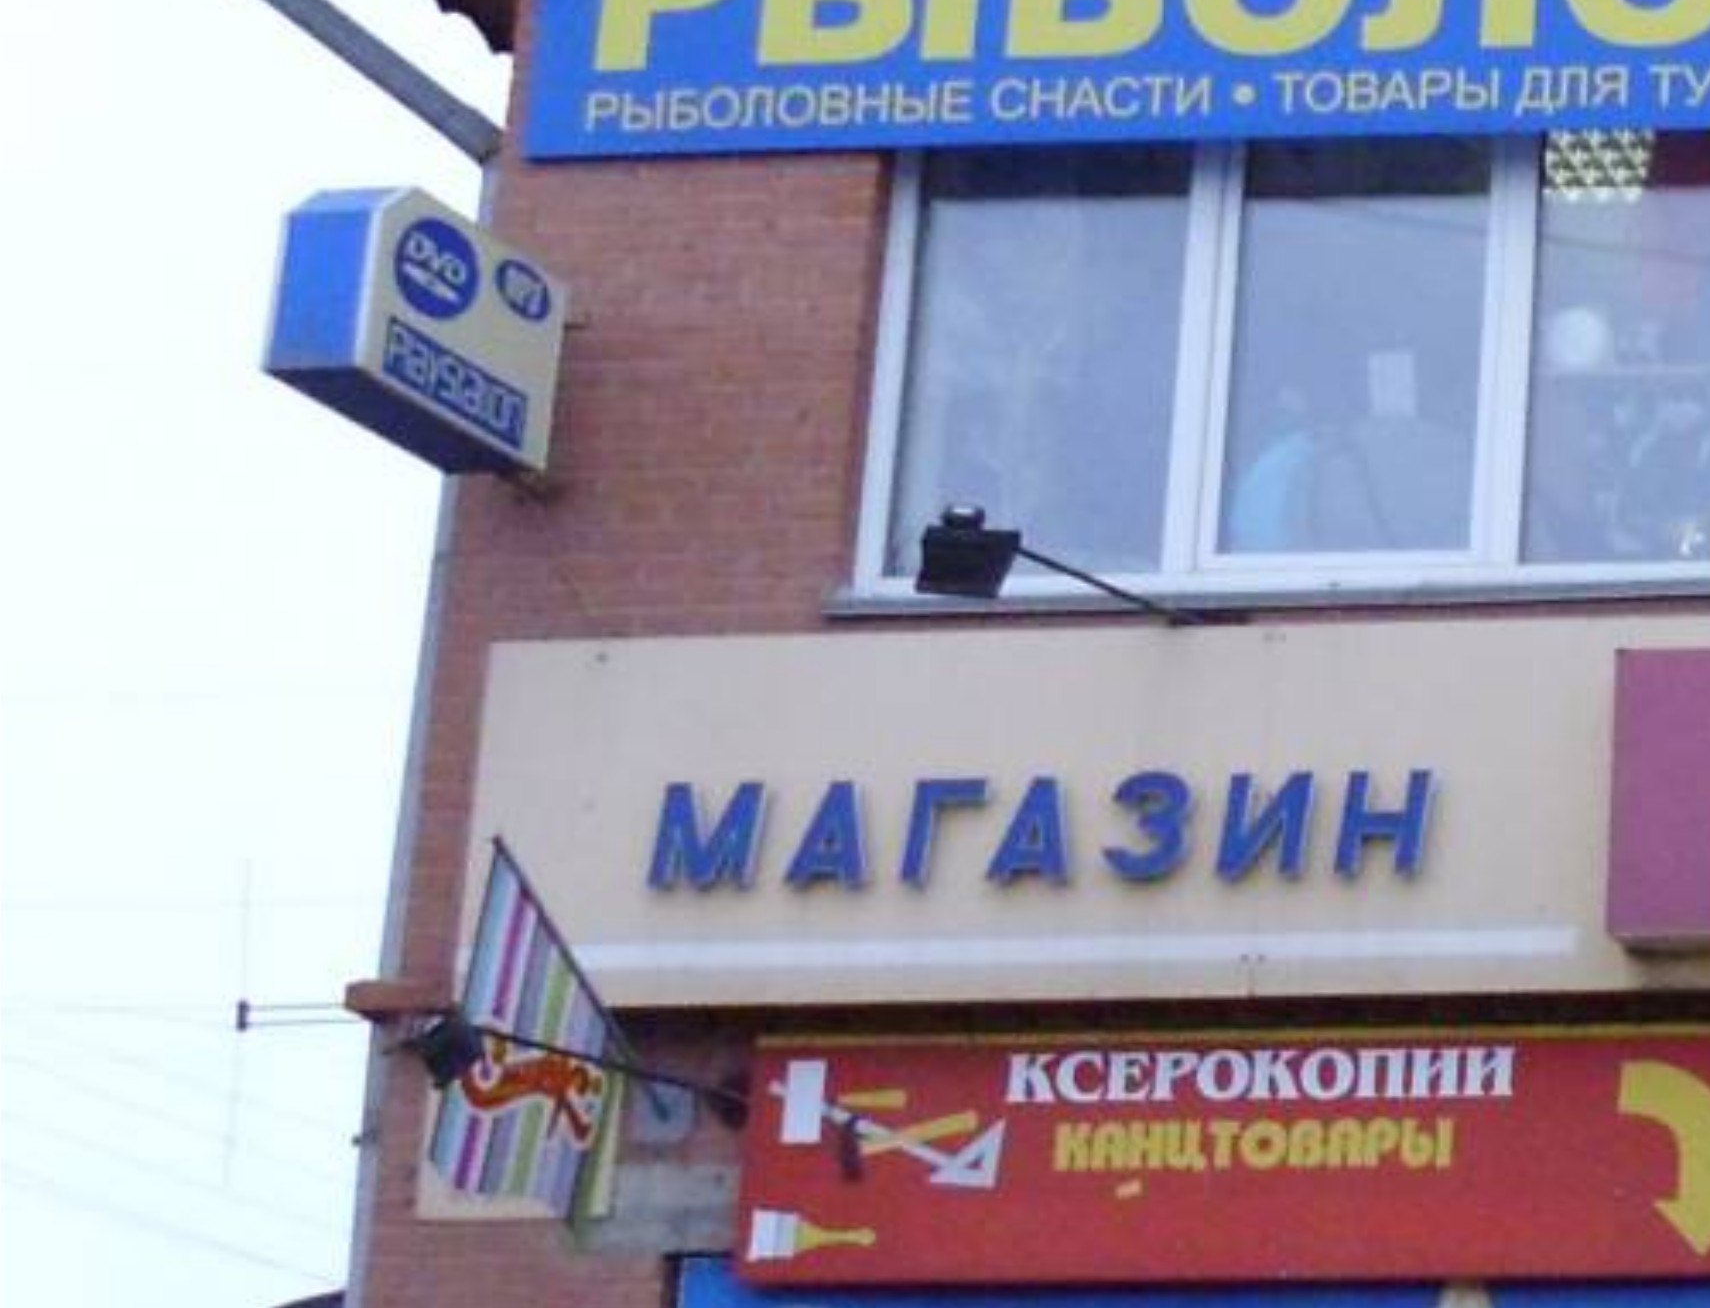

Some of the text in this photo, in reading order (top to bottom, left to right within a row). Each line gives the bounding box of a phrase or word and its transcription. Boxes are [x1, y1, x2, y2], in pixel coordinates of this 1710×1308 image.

[584, 76, 973, 132] РЫБОЛОВНЫЕ
[989, 70, 1213, 122] СНАСТИ
[1275, 64, 1500, 114] ТОВАРЫ
[1515, 62, 1629, 117] ДЛЯ
[646, 768, 1437, 892] МАГАЗИН
[1007, 1046, 1516, 1104] КСЕРОКОПИИ
[1053, 1119, 1453, 1173] КАНЦТОВАРЫ
